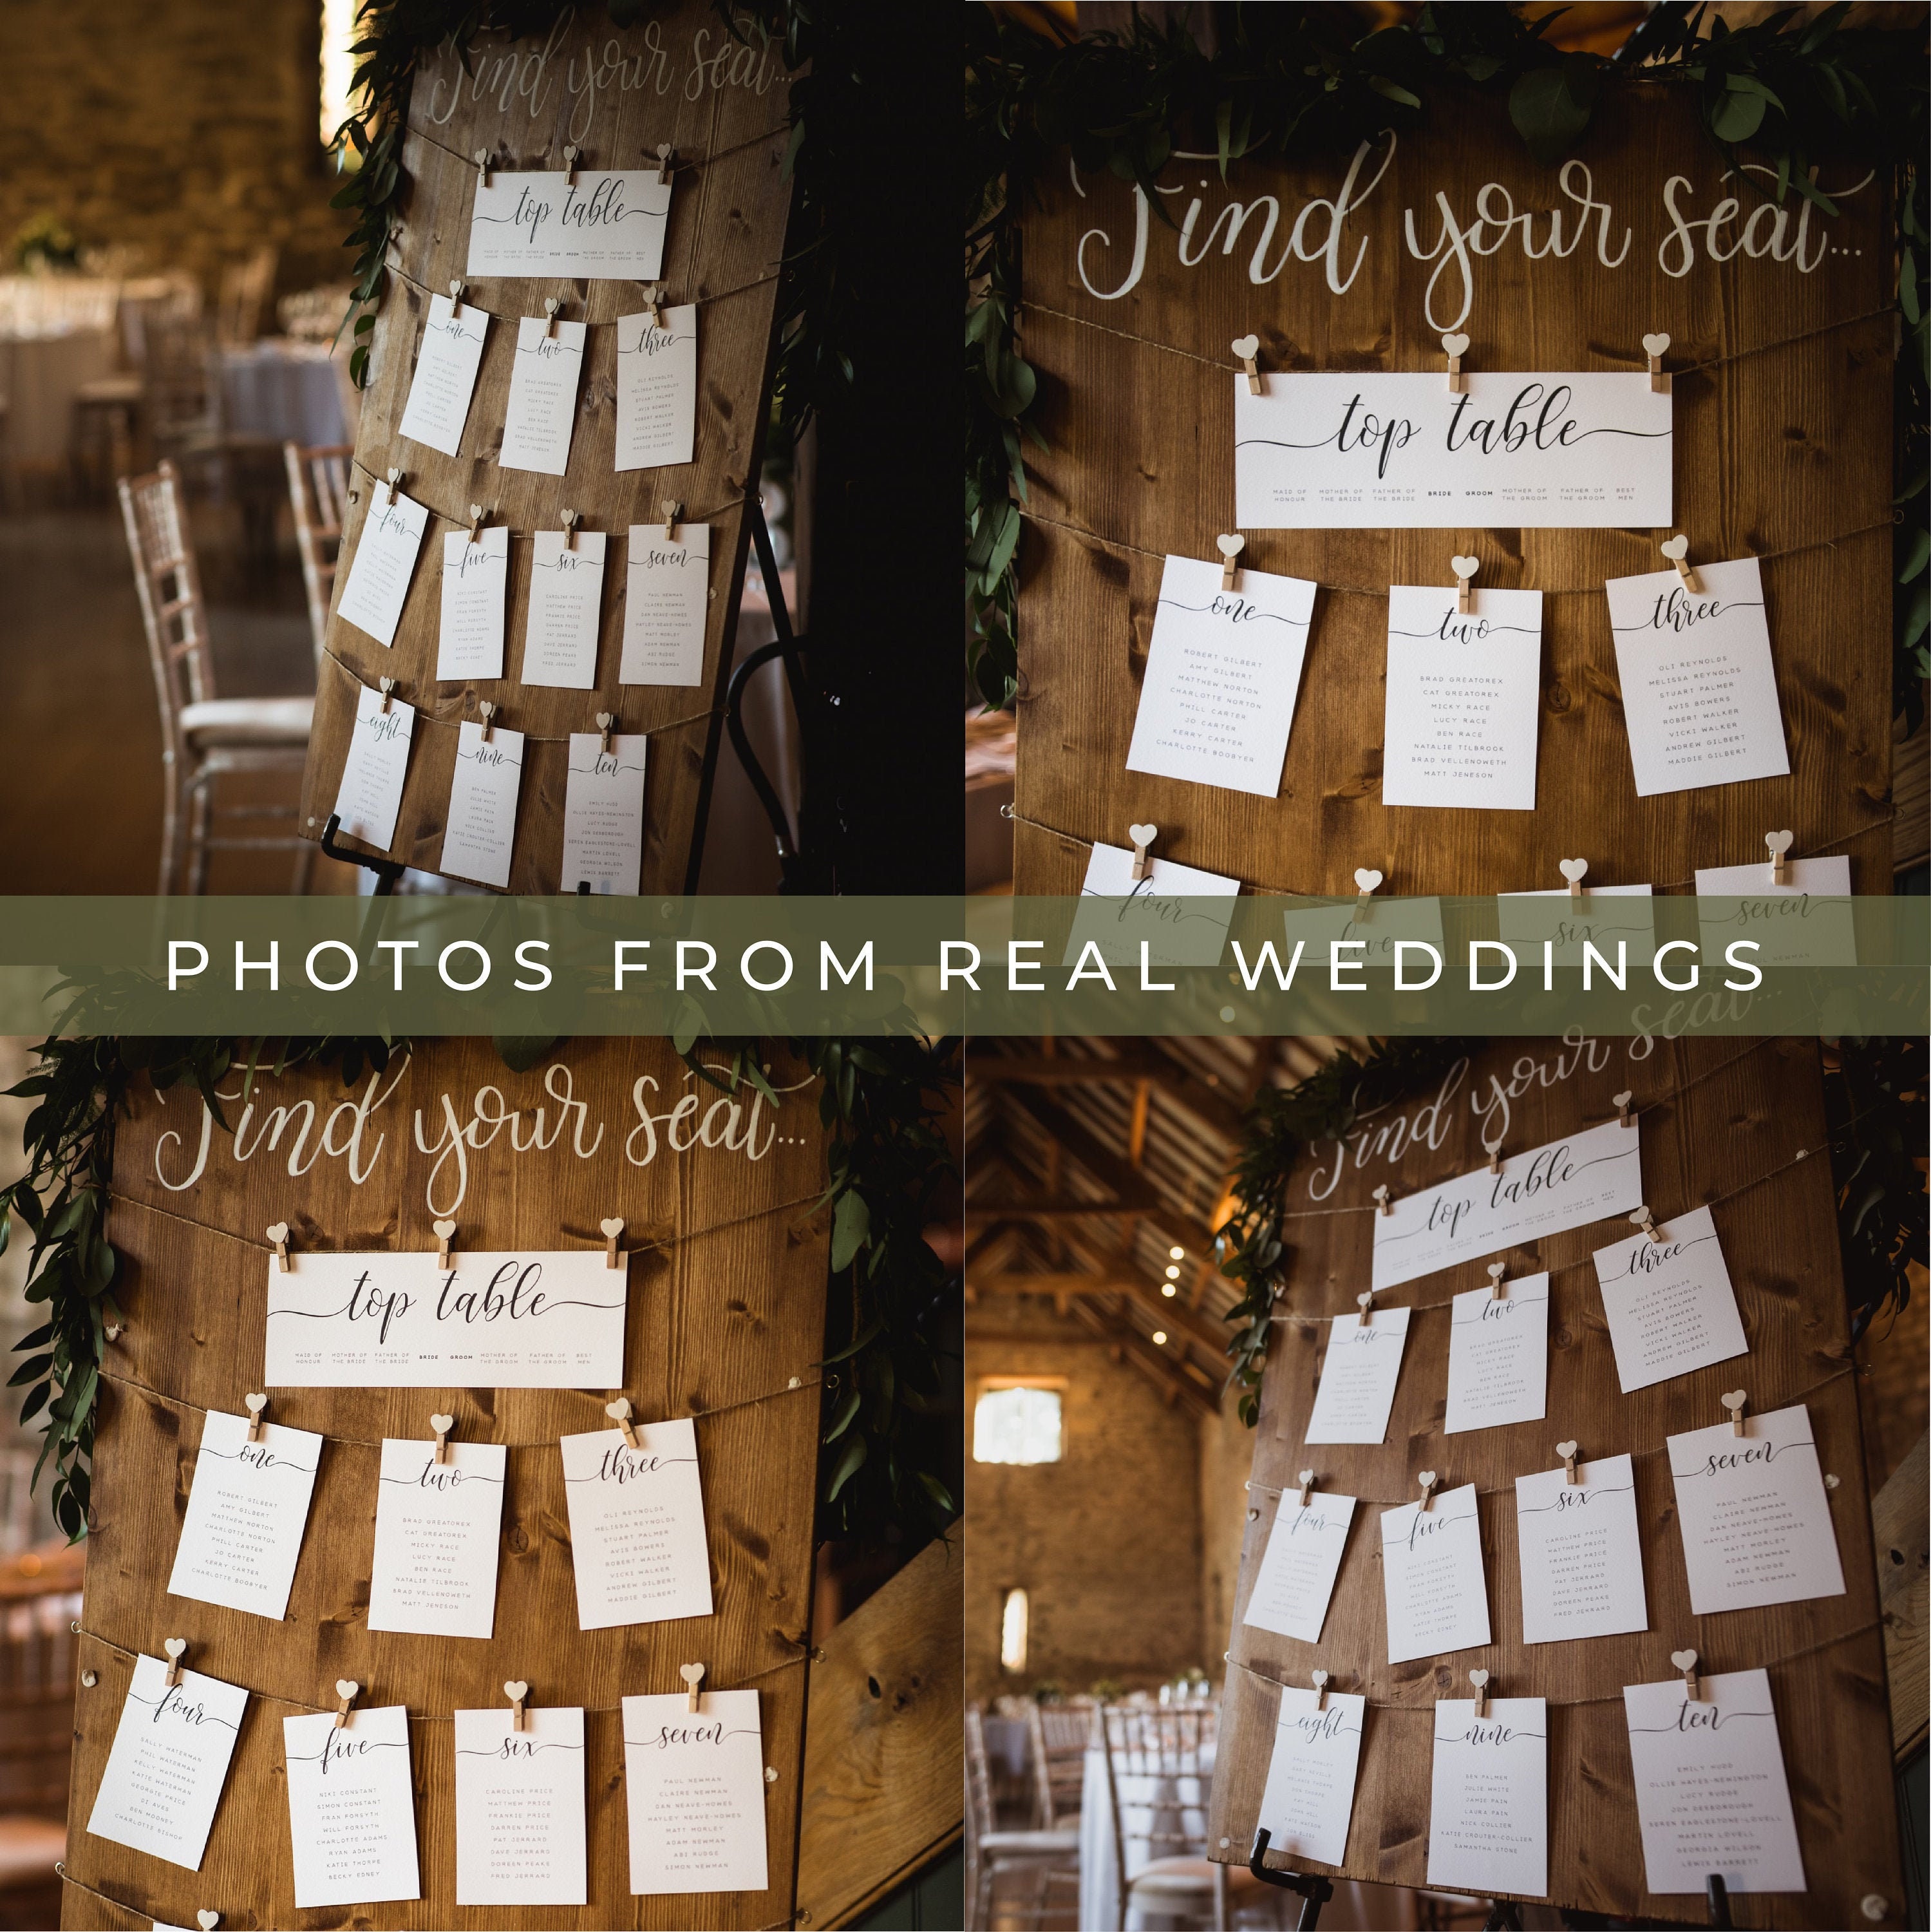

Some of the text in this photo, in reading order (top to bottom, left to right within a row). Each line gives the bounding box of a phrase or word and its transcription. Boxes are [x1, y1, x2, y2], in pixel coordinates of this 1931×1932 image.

[569, 20, 675, 144] your
[509, 178, 629, 244] top table
[1405, 158, 1632, 333] your
[633, 325, 680, 356] three
[1314, 383, 1594, 479] top table
[379, 502, 409, 536] four
[458, 542, 489, 578] five
[645, 549, 691, 569] seven
[1645, 587, 1728, 632] three
[1183, 649, 1261, 668] ROBERT GILBERT
[1679, 656, 1727, 667] REYNOLDS
[1178, 675, 1258, 694] MATTHEW NORTON
[1213, 668, 1251, 679] GILBERT
[1648, 667, 1740, 686] MELISSA REYNOLDS
[1169, 687, 1261, 708] CHARLOTTE NORTON
[1659, 682, 1734, 697] STUART PALMER
[1694, 696, 1730, 706] BOWERS
[1179, 703, 1246, 719] PHILL CARTER
[1663, 708, 1738, 724] ROBERT WALKER
[366, 712, 402, 742] eight
[1173, 729, 1243, 746] KERRY CARTER
[1201, 721, 1236, 731] CARTER
[1701, 723, 1737, 732] WALKER
[1156, 739, 1207, 753] CHARLOTTE
[1665, 735, 1745, 751] ANDREW GILBERT
[1668, 748, 1746, 764] MADDIE GILBERT
[1111, 875, 1189, 923] four
[1733, 893, 1816, 926] seven
[1470, 1024, 1612, 1145] your
[414, 1063, 603, 1217] your
[1421, 1144, 1579, 1239] top table
[1621, 1240, 1689, 1276] three
[335, 1260, 558, 1345] top table
[594, 1444, 664, 1484] three
[1703, 1442, 1777, 1476] seven
[1286, 1505, 1332, 1535] four
[1404, 1510, 1451, 1551] five
[150, 1683, 207, 1725] four
[654, 1722, 728, 1749] seven
[1294, 1706, 1350, 1745] eight
[140, 1737, 202, 1762] SALLY WATERMAN
[315, 1727, 373, 1775] five
[133, 1759, 195, 1784] KELLY WATERMAN
[159, 1756, 196, 1772] WATERMAN
[130, 1782, 185, 1805] GEORGIE PRICE
[131, 1770, 191, 1795] KATIE WATERMAN
[145, 1812, 173, 1824] MOONEY
[152, 1803, 169, 1811] AVES
[114, 1813, 182, 1841] CHARLOTTE BISHOP
